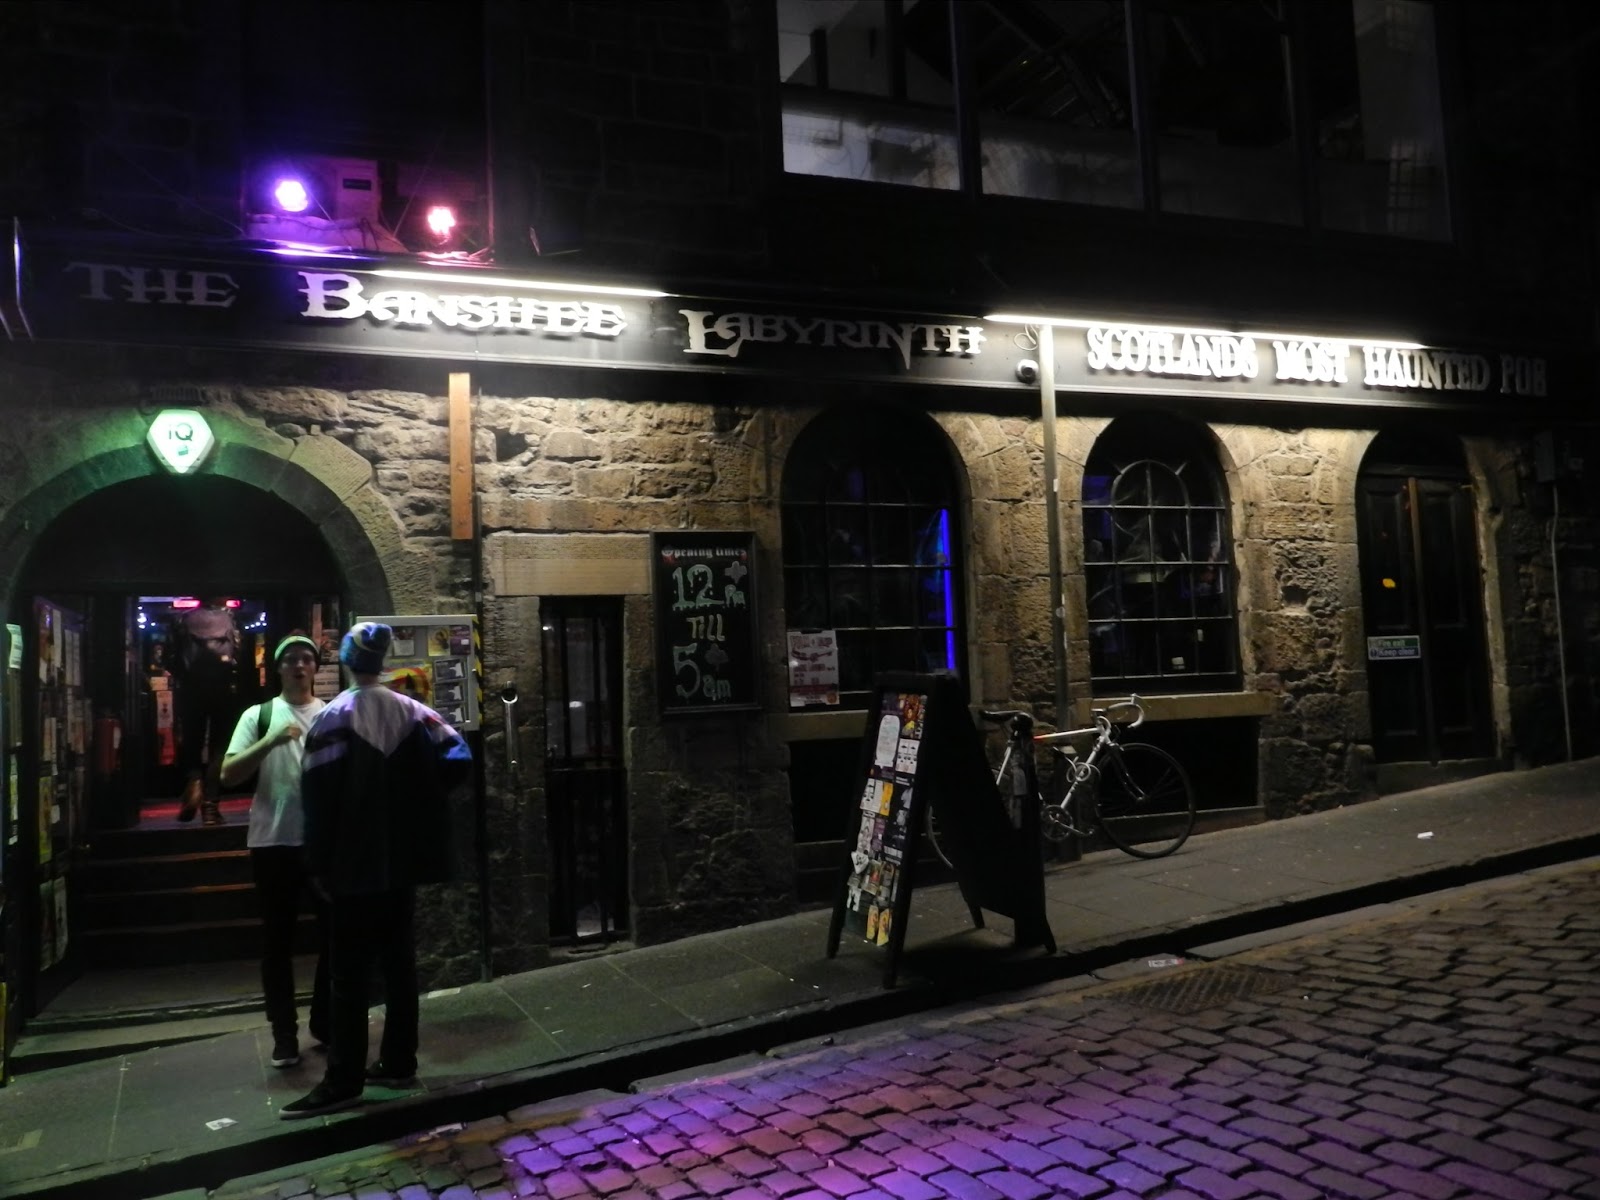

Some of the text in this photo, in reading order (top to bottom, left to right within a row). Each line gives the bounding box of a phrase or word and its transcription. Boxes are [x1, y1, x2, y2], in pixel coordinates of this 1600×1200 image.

[63, 261, 240, 308] THE
[679, 309, 987, 370] LABYRINTH
[1273, 340, 1350, 383] MOST
[1363, 345, 1491, 392] HAUNTED
[1500, 353, 1548, 397] PUB
[672, 564, 726, 611] 12
[672, 642, 701, 699] 5
